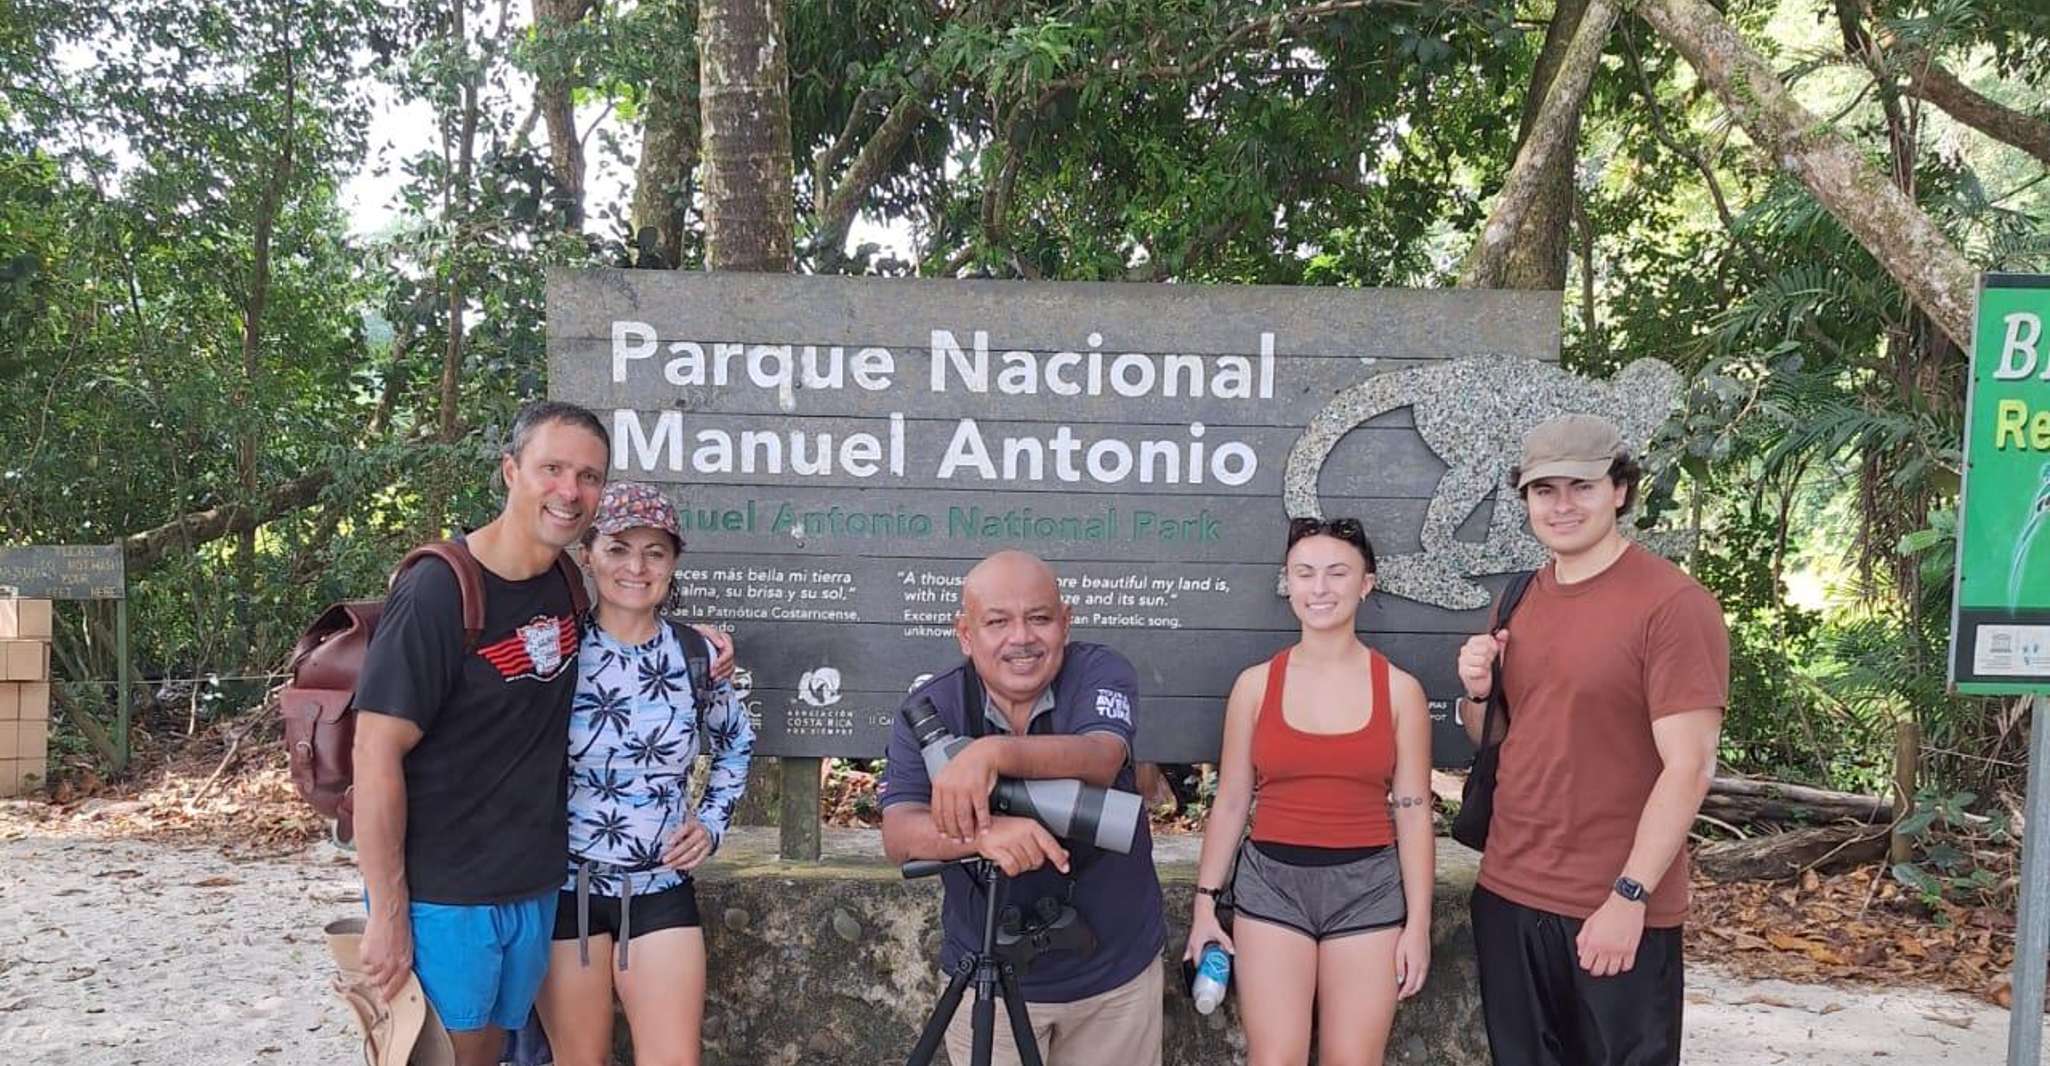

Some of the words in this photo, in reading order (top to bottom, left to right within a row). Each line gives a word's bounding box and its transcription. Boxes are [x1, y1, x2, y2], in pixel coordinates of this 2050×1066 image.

[610, 320, 896, 411] Parque
[929, 329, 1276, 400] Nacional
[611, 409, 904, 478] Manuel
[938, 421, 1259, 486] Antonio
[679, 500, 757, 532] nuel
[770, 502, 933, 538] Antonio
[948, 506, 1119, 542] National
[1132, 509, 1223, 543] Park
[674, 568, 709, 580] eces
[713, 567, 744, 581] más
[747, 568, 784, 582] bella
[788, 569, 808, 582] mi
[812, 569, 852, 584] tierra
[1082, 574, 1148, 590] beautiful
[1151, 577, 1175, 594] my
[1178, 576, 1212, 592] land
[1215, 577, 1231, 594] is,
[677, 582, 720, 600] alma,
[725, 586, 742, 598] su
[747, 584, 783, 599] brisa
[787, 589, 796, 602] y
[800, 588, 817, 600] su
[904, 587, 937, 602] with
[941, 587, 958, 602] its
[1085, 592, 1115, 607] and
[1118, 592, 1136, 607] its
[692, 604, 704, 617] la
[904, 609, 952, 624] Excerpt
[1093, 612, 1145, 627] Patriotic
[787, 718, 823, 728] COSTA
